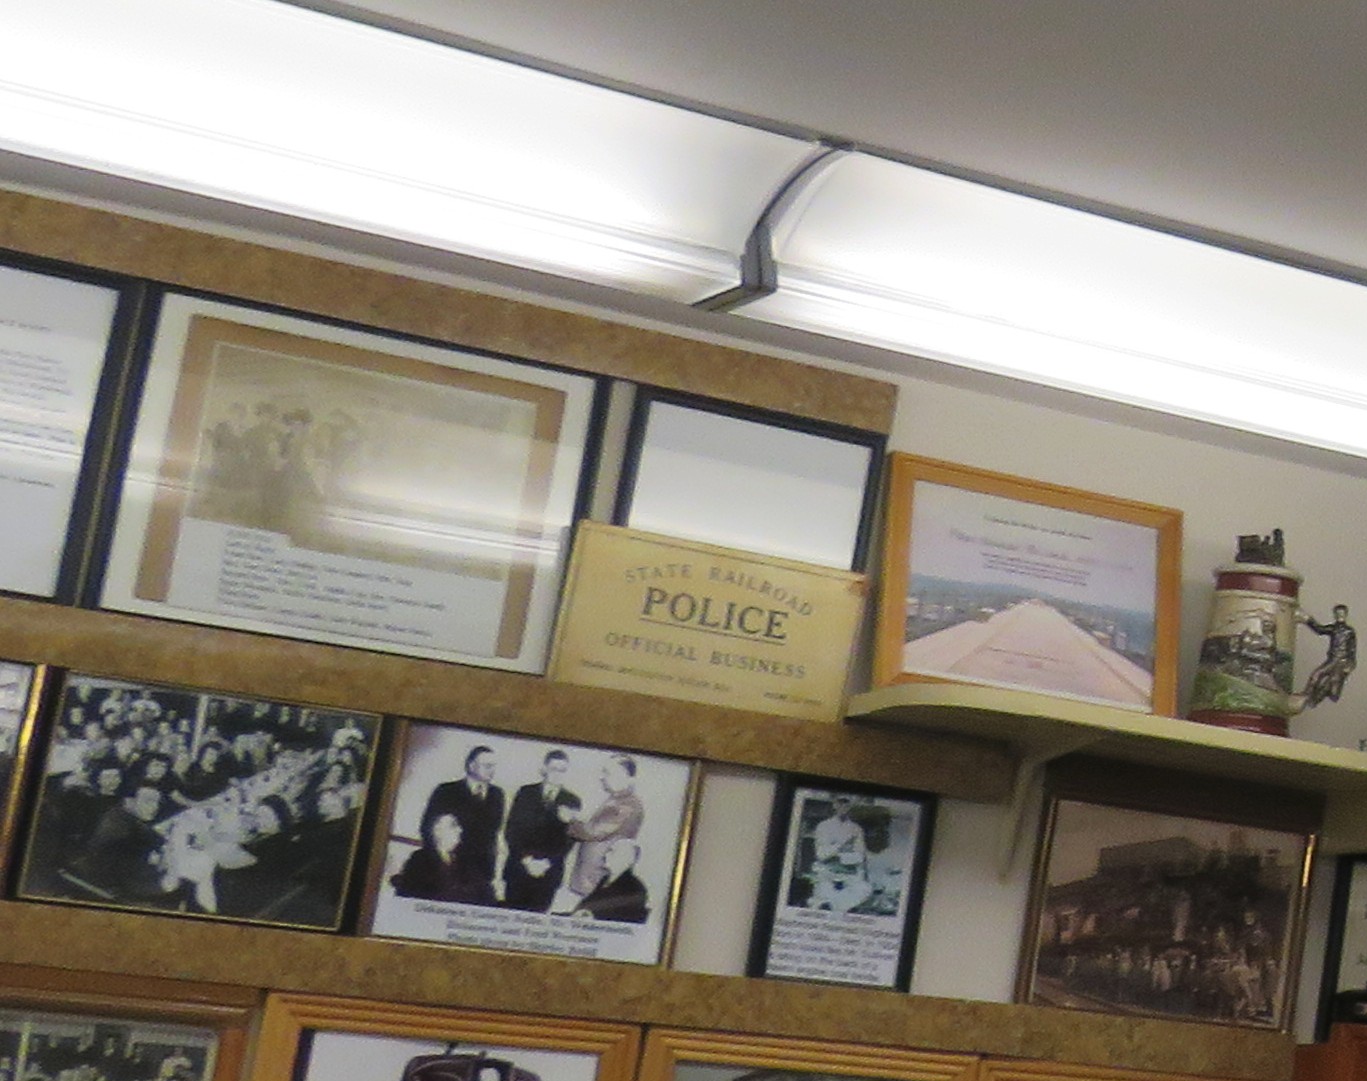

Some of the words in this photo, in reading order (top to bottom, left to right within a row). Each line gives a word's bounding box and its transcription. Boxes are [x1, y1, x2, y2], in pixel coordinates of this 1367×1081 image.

[625, 564, 692, 583] STATE
[709, 565, 813, 616] RAILROAD
[640, 586, 790, 640] POLICE
[604, 632, 697, 661] OFFICIAL
[709, 650, 807, 680] BUSINESS
